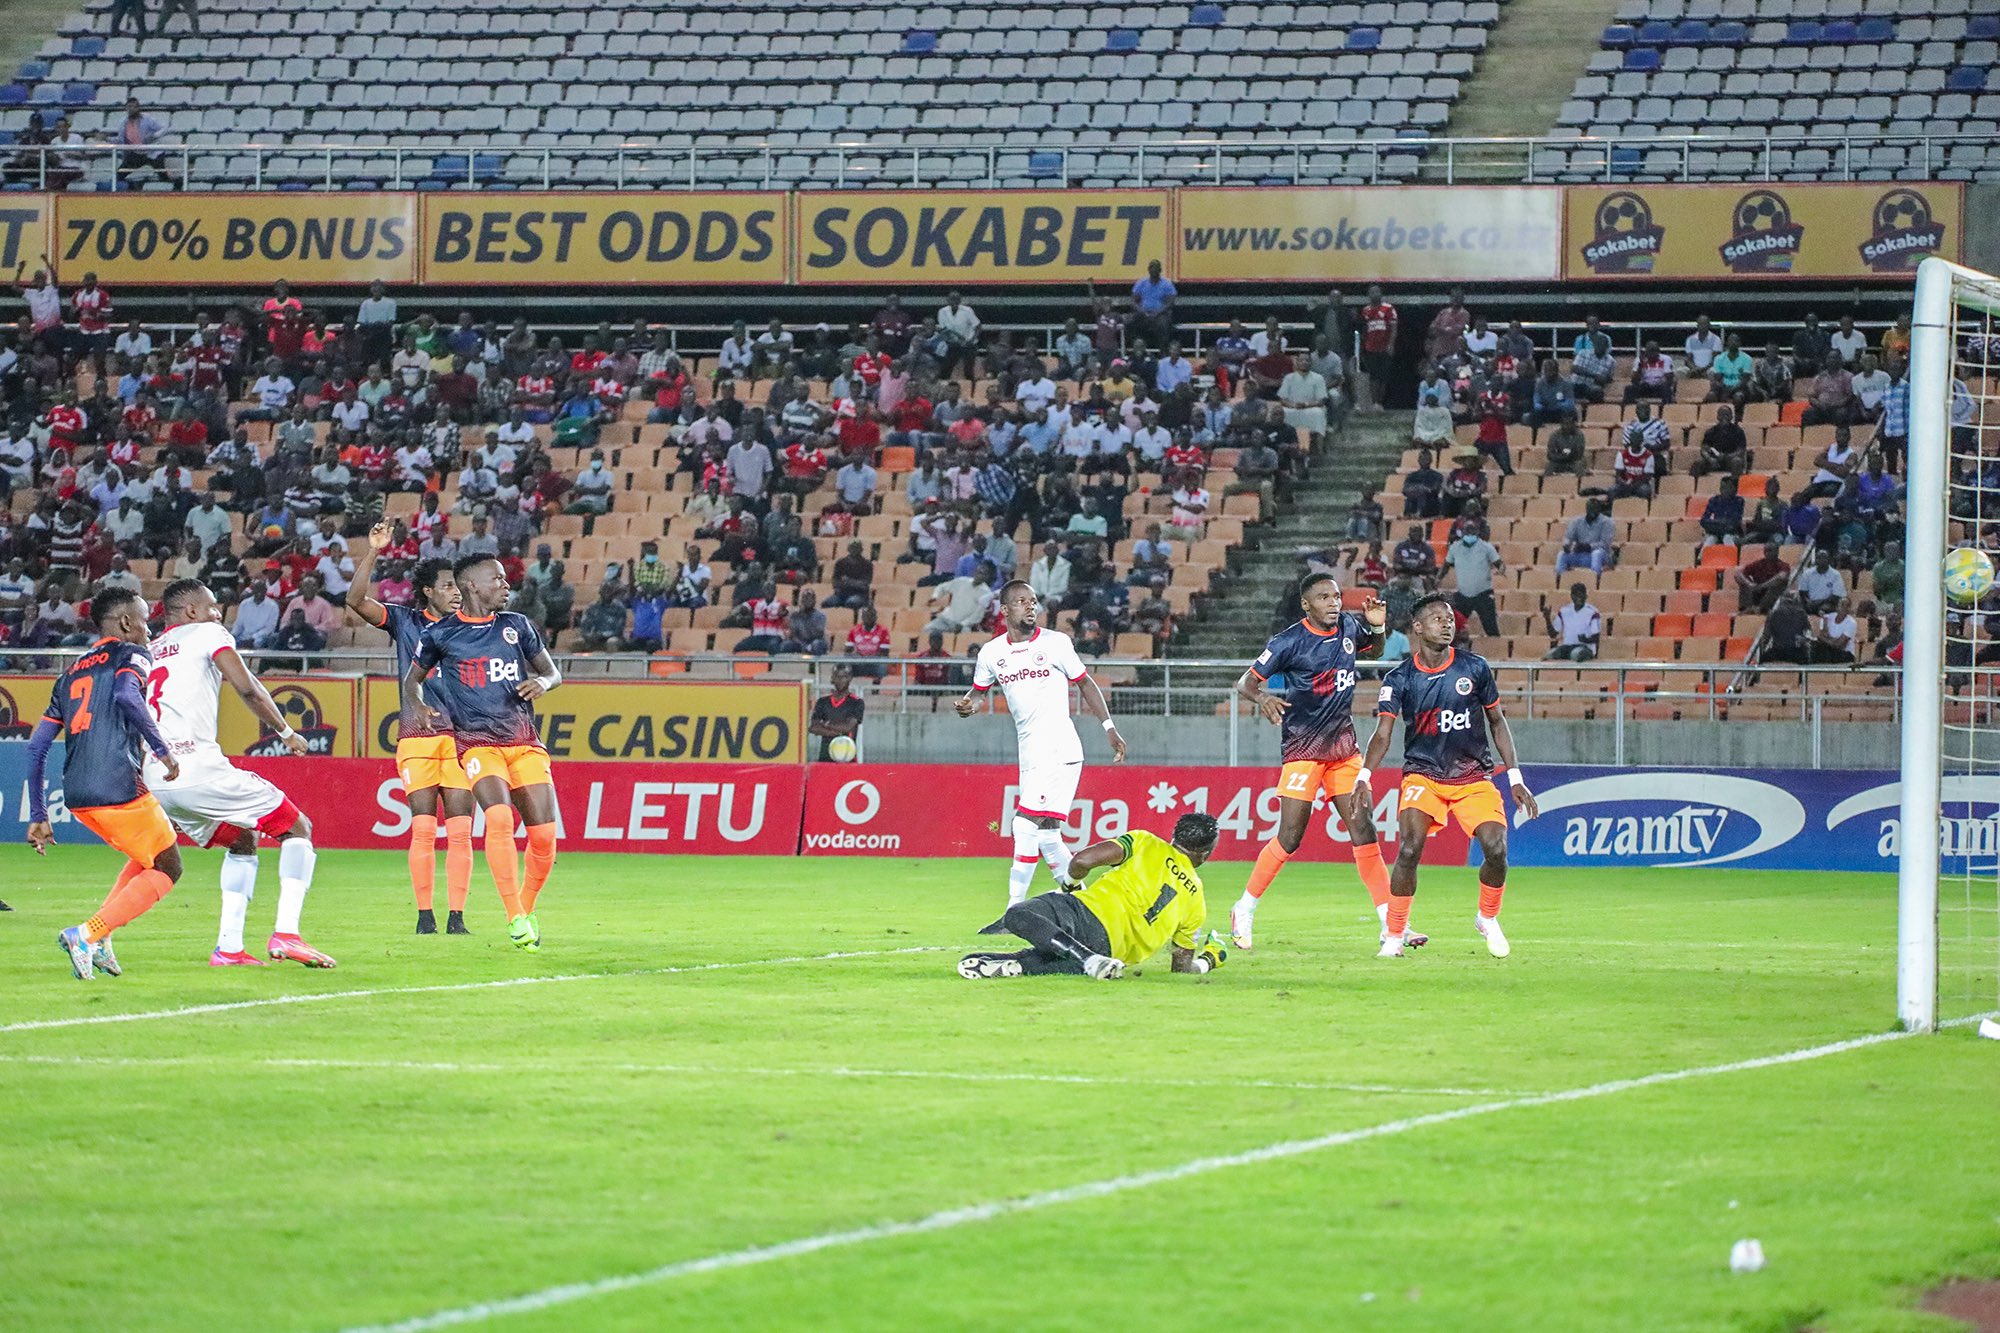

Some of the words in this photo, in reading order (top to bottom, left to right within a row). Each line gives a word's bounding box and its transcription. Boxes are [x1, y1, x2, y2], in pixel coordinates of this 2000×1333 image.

[64, 218, 210, 261] 700%
[223, 217, 406, 261] BONUS
[434, 211, 587, 263] BEST
[598, 210, 775, 263] ODDS
[807, 205, 1161, 268] SOKABET
[1586, 235, 1656, 261] Sokabet
[1724, 234, 1795, 261] Sokabet
[1864, 233, 1936, 260] Sokabet
[70, 675, 93, 735] 2
[588, 714, 789, 759] CASINO
[1286, 772, 1309, 791] 22
[583, 782, 768, 842] LETU
[805, 829, 901, 849] vodacom
[1165, 857, 1198, 896] COPER
[1143, 882, 1178, 926] 1
